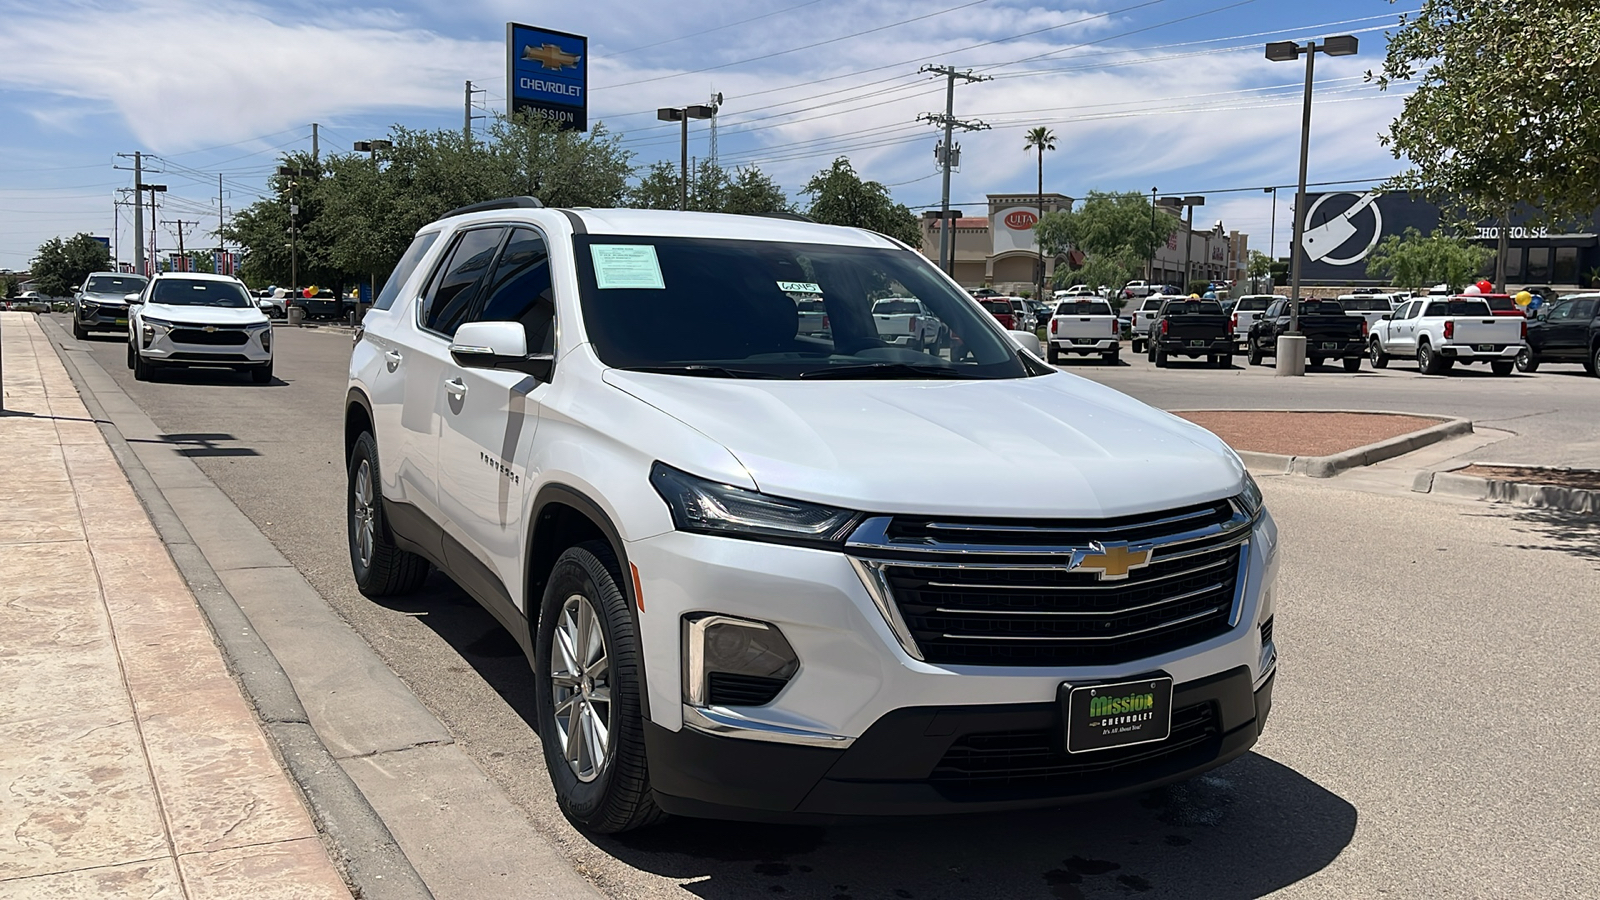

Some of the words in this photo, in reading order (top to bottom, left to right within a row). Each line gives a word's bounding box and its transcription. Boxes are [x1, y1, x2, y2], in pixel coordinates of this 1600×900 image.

[520, 77, 582, 97] CHEVROLET
[1010, 214, 1034, 224] ULTA
[1474, 226, 1548, 239] CHOHOUSE
[1090, 692, 1153, 717] Mission
[1101, 712, 1153, 727] CHEVROLET
